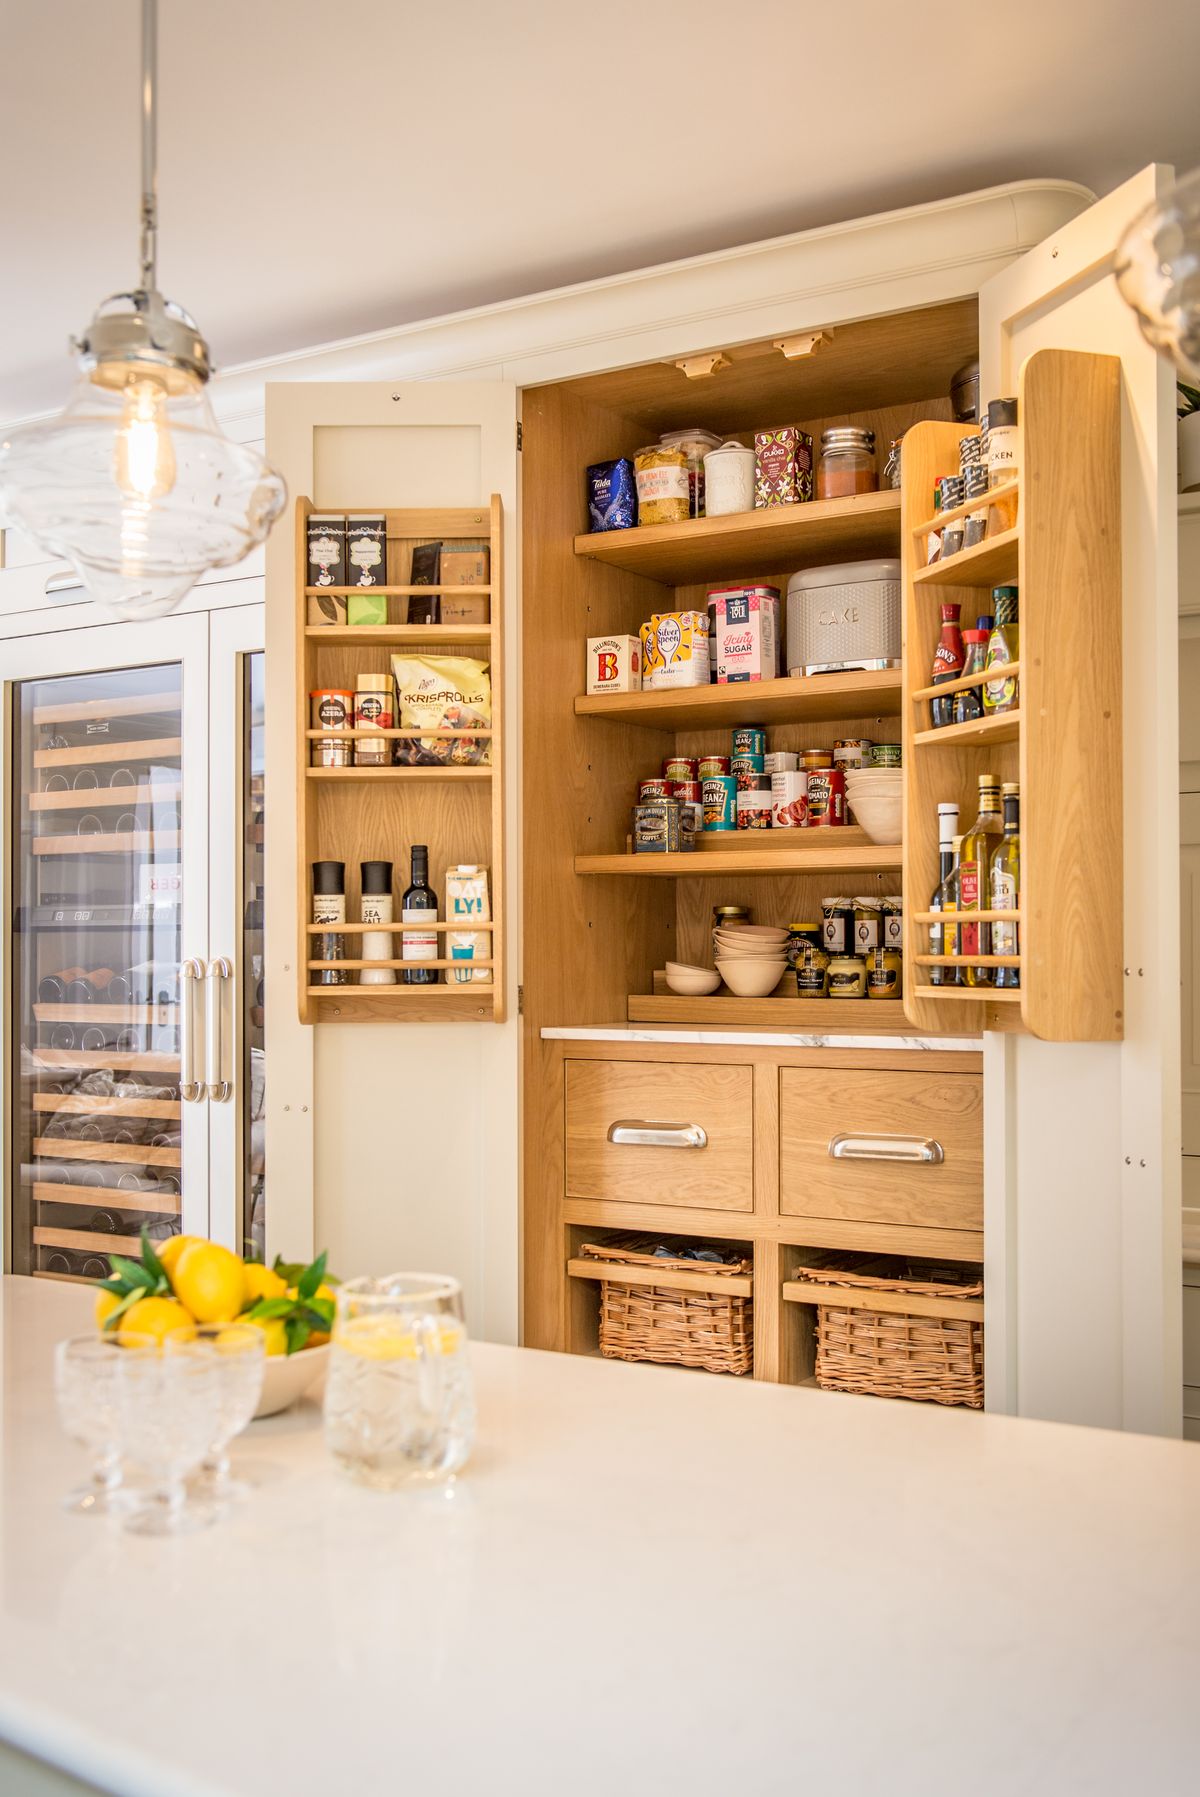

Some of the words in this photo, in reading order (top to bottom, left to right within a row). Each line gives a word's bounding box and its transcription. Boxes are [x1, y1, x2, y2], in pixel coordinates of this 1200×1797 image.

[763, 448, 785, 459] pukka
[592, 478, 611, 489] Tilda
[818, 607, 860, 626] CAKE
[657, 627, 679, 637] Silver
[657, 635, 679, 647] Spoon
[723, 632, 754, 646] Icing
[724, 645, 753, 654] SUGAR
[597, 652, 619, 682] B
[404, 691, 484, 704] KRISPROLLS
[704, 782, 723, 791] HEINZ
[808, 777, 826, 786] HEINZ
[642, 786, 662, 795] HEINZ
[965, 884, 975, 892] OIL
[454, 897, 483, 914] LY!
[364, 910, 380, 918] SEA
